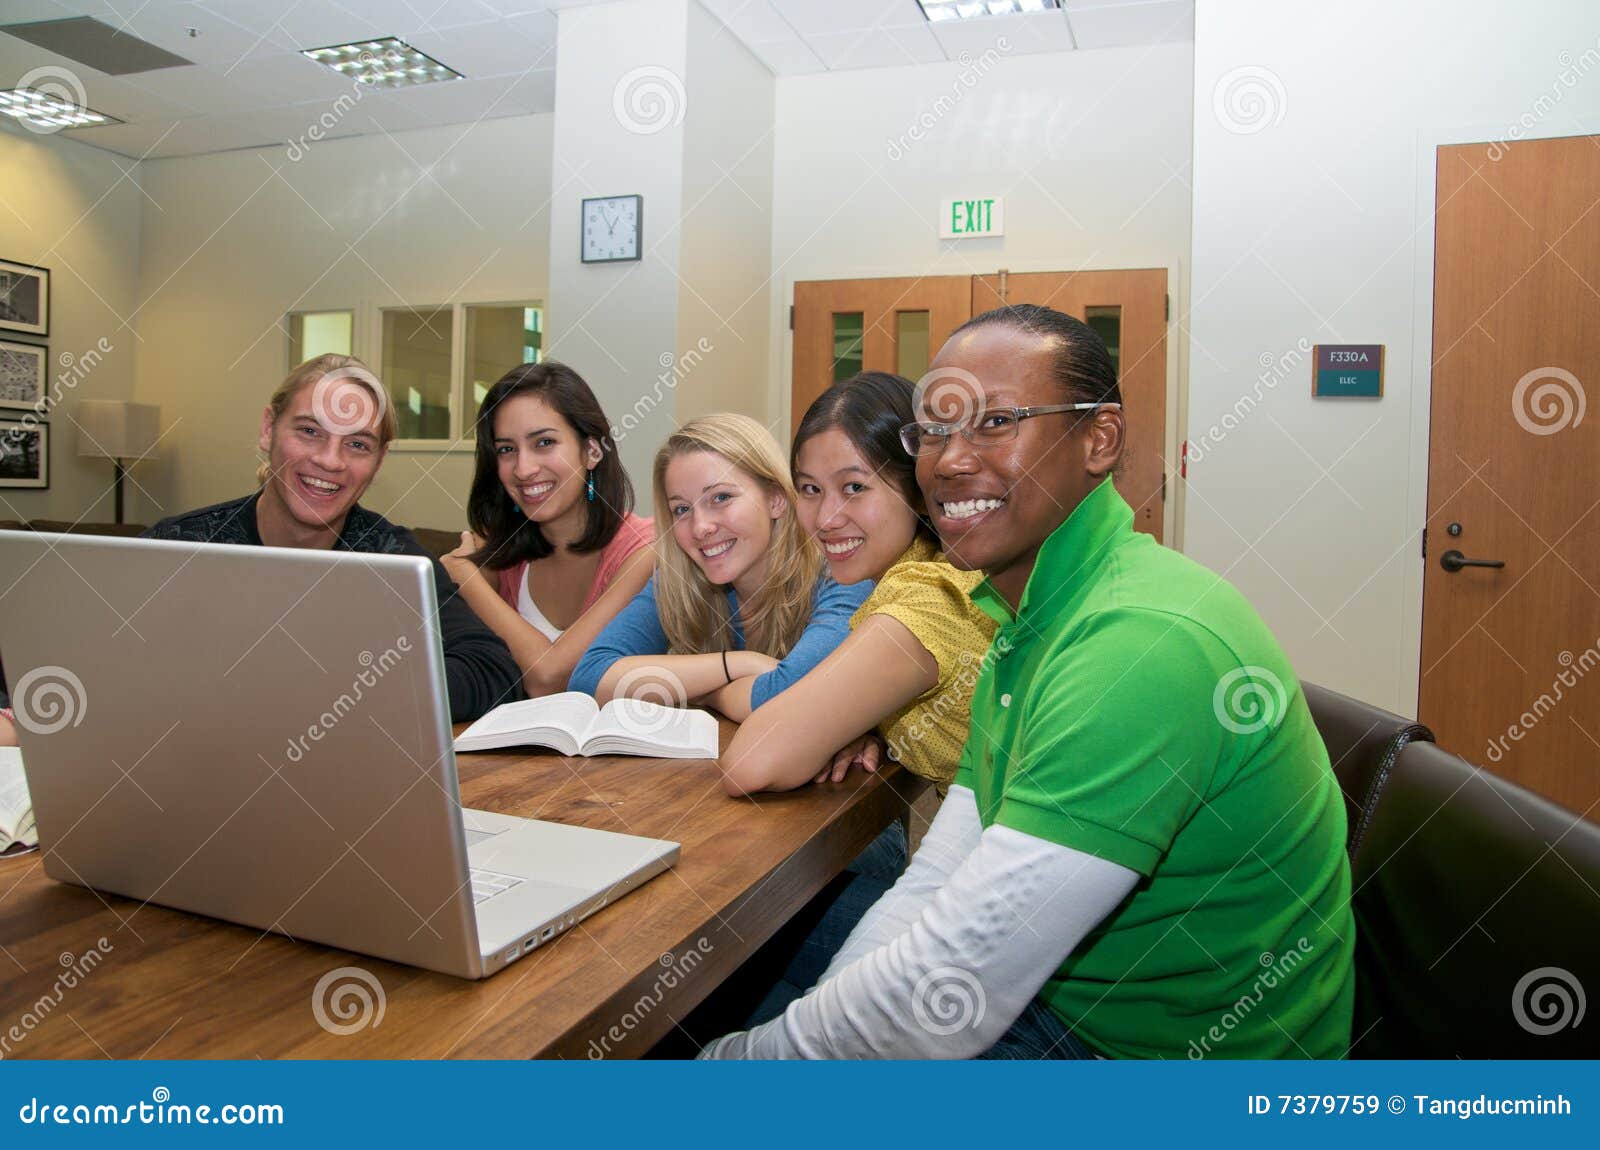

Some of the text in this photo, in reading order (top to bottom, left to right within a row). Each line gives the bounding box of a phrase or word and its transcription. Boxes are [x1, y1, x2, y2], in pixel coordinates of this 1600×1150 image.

[951, 199, 994, 233] EXIT
[1330, 351, 1369, 362] F330A
[1339, 376, 1357, 384] ELEC
